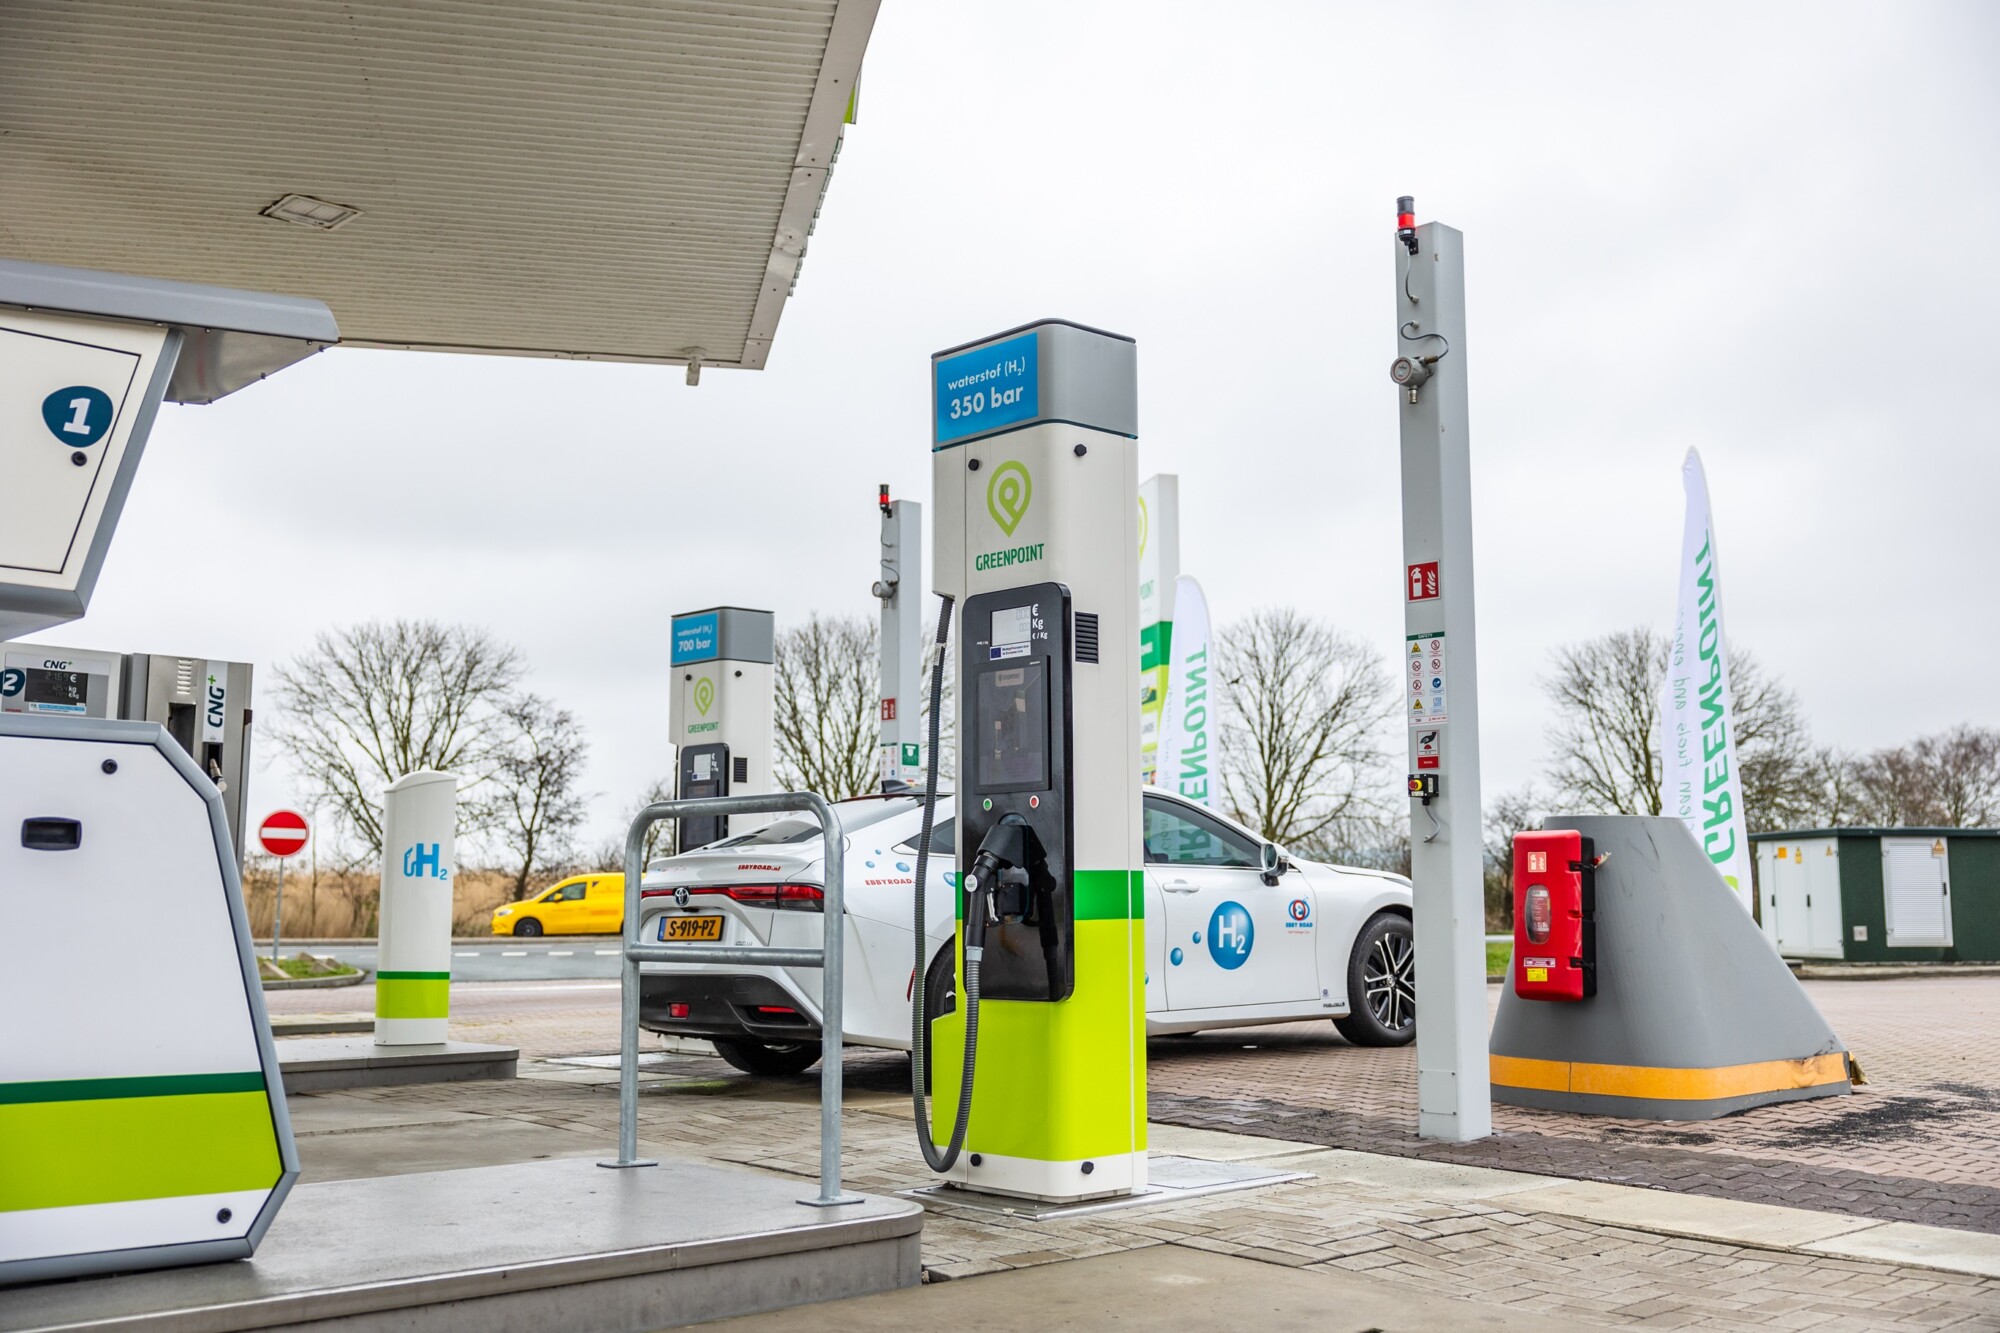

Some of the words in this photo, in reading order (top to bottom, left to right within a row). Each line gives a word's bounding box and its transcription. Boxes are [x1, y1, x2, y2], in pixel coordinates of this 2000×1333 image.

[947, 363, 1001, 391] waterstof
[950, 392, 985, 419] 350
[991, 386, 1024, 409] bar
[63, 397, 91, 435] 1
[975, 543, 1044, 571] GREENPOINT
[1032, 618, 1044, 630] Kg
[678, 639, 695, 653] 700
[695, 637, 712, 650] bar
[2, 673, 18, 691] 2
[737, 864, 782, 872] EBBYROAD.nl
[864, 878, 916, 886] EBBYROAD.
[668, 919, 717, 937] S-919-PZ
[1218, 914, 1246, 955] H2
